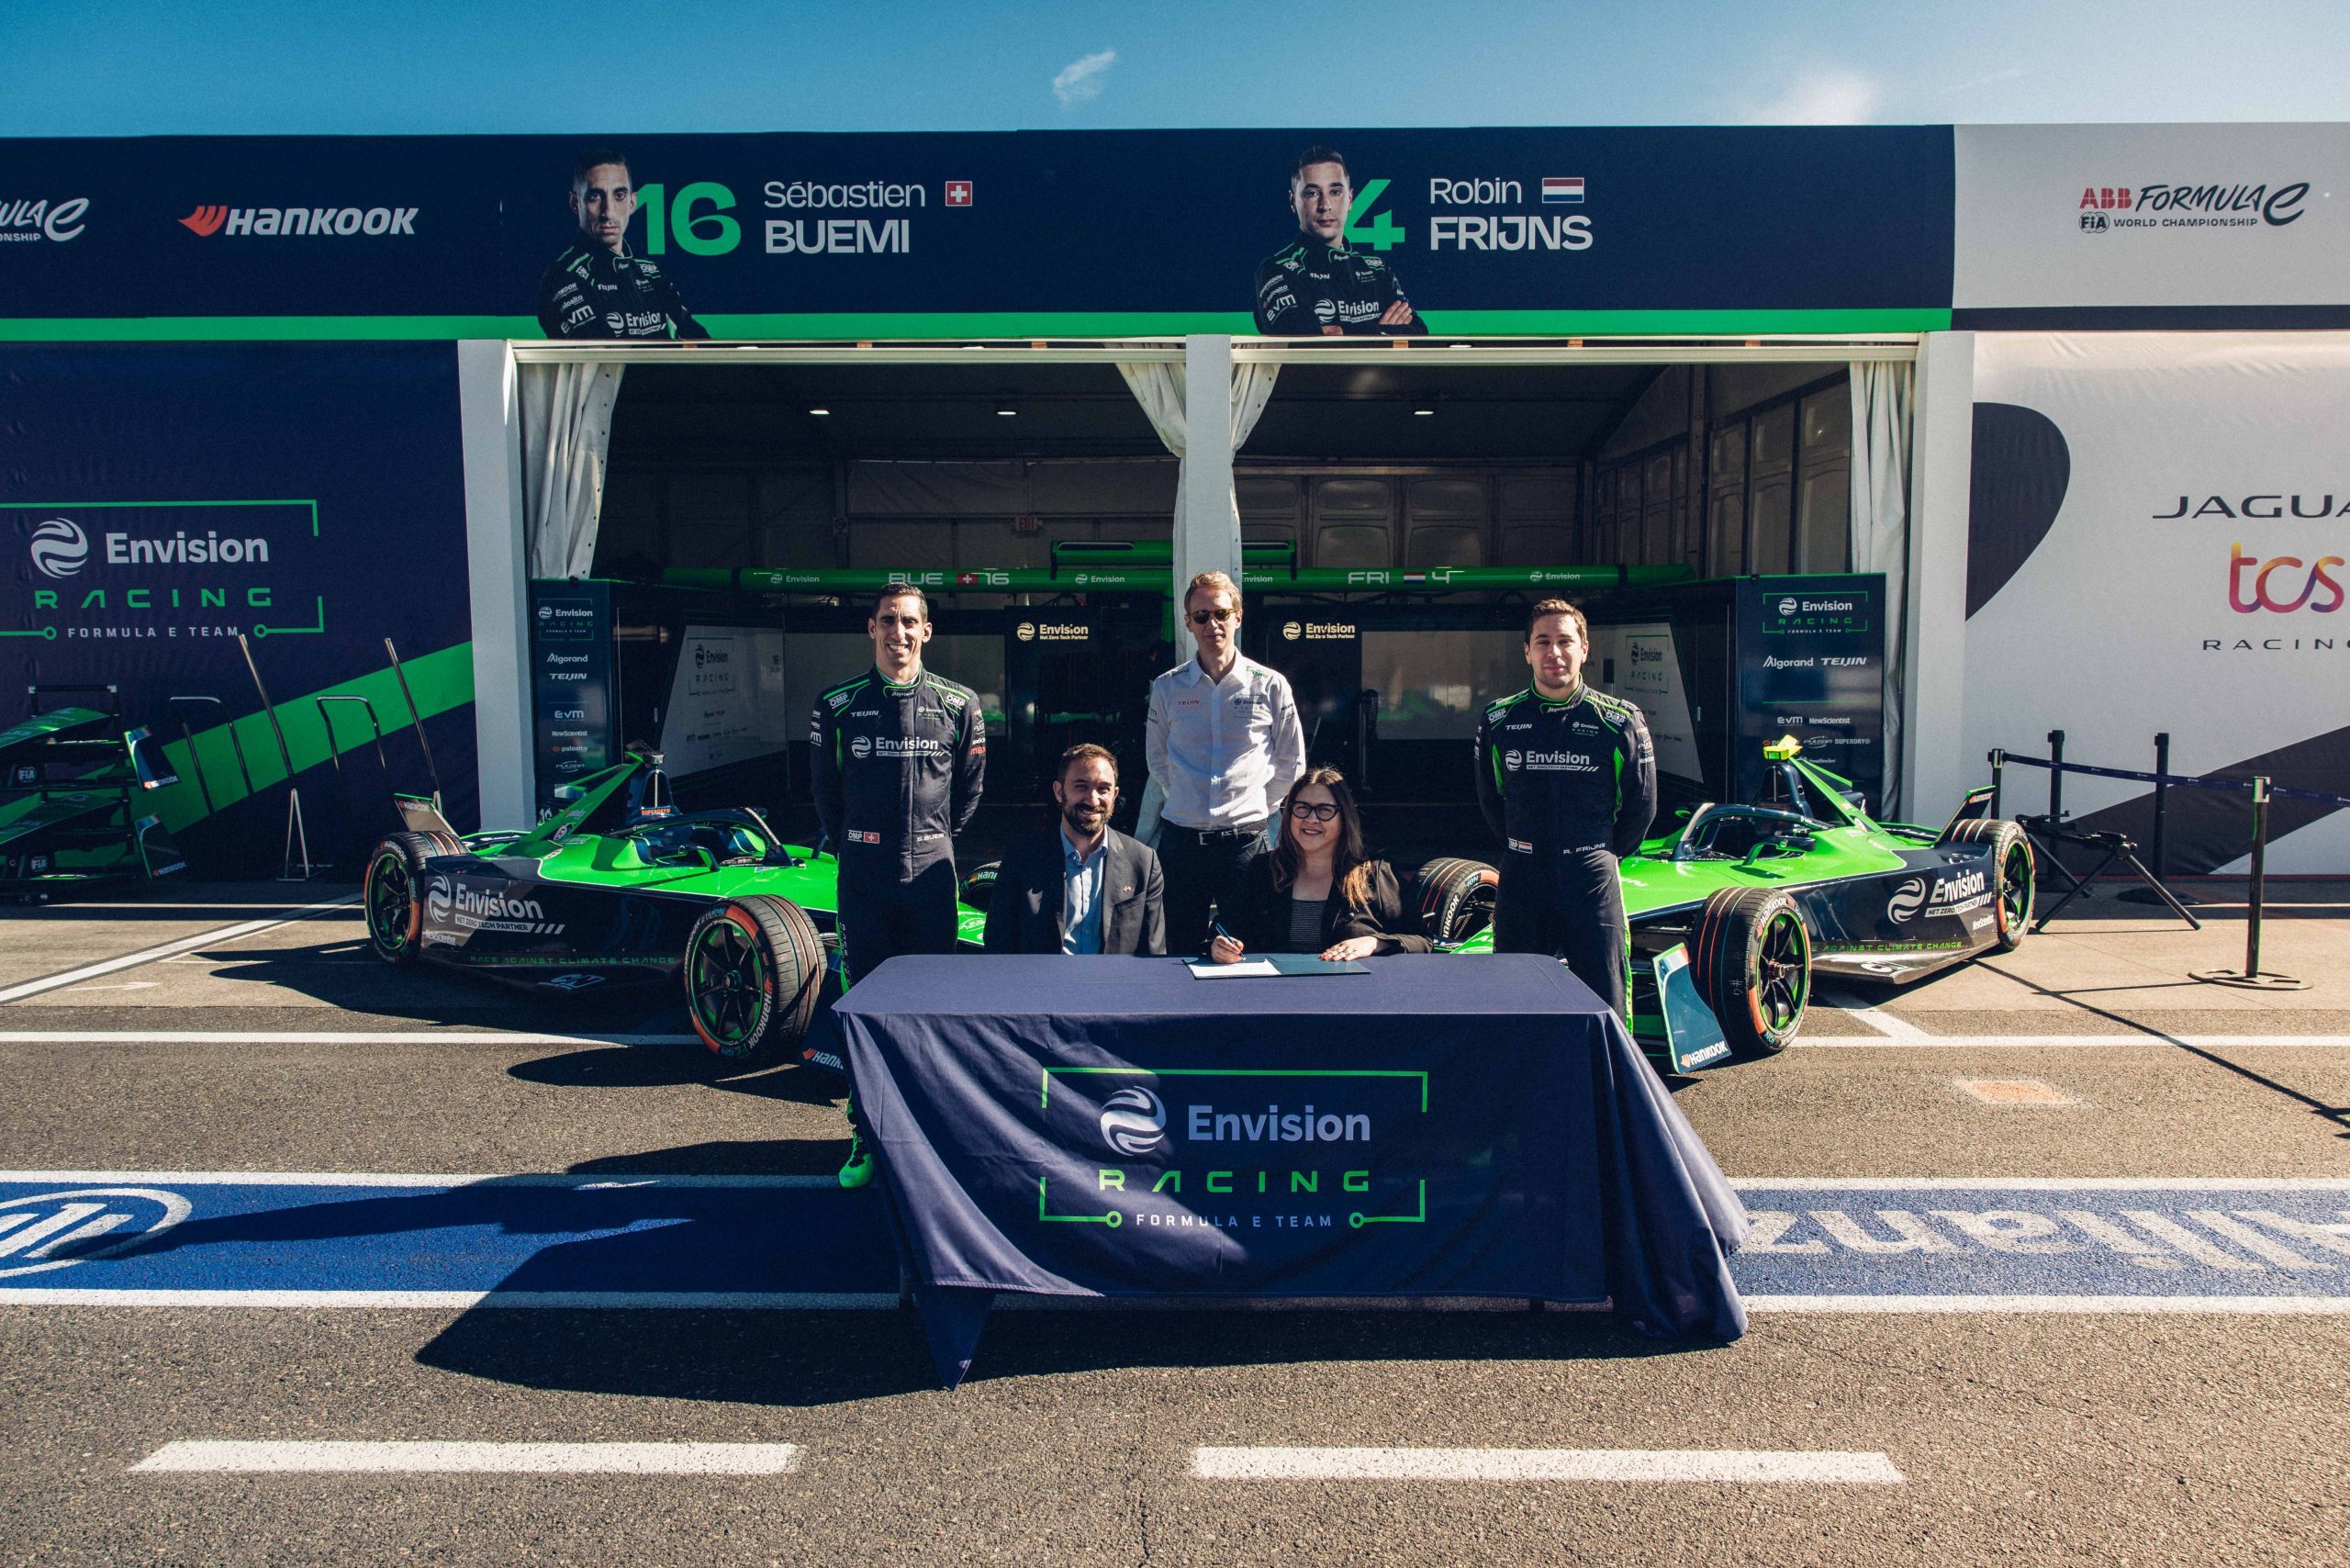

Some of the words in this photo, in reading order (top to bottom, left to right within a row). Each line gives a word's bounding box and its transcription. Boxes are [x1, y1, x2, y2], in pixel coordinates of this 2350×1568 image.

[764, 181, 925, 207] Sébastien
[1430, 177, 1521, 204] Robin
[2079, 188, 2132, 209] ABB
[2135, 185, 2267, 212] FORMULA
[0, 199, 48, 228] ULA
[632, 182, 742, 255] 16
[1345, 179, 1405, 251] 4
[2114, 218, 2157, 228] WORLD
[2162, 218, 2258, 228] CHAMPIONSHIP
[0, 232, 42, 242] NSHIP
[766, 219, 910, 253] BUEMI
[1430, 216, 1593, 251] FRIJNS
[106, 531, 269, 564] Envision
[786, 575, 820, 583] Envision
[889, 573, 944, 585] BUE
[985, 573, 1010, 585] 16
[1091, 575, 1125, 583] Envision
[1348, 572, 1390, 585] FRI
[1432, 572, 1449, 584] 4
[1546, 572, 1581, 580] Envision
[35, 588, 272, 609] RACING
[1802, 600, 1852, 611] Envision
[555, 609, 593, 617] Envision
[1778, 617, 1852, 625] RACING
[68, 627, 156, 638] FORMULA
[168, 627, 177, 637] E
[189, 626, 238, 637] TEAM
[1039, 624, 1088, 634] Envision
[1306, 623, 1356, 633] Envision
[547, 653, 588, 664] Algorand
[1762, 655, 1814, 669] Algorand
[1821, 657, 1867, 666] TEIJIN
[829, 693, 849, 706] OMP
[946, 695, 966, 707] OMP
[1488, 710, 1506, 722] OMP
[1606, 711, 1625, 724] OMP
[876, 736, 939, 750] Envision
[1527, 751, 1590, 766] Envision
[848, 832, 863, 840] OMP
[1576, 843, 1606, 853] FRIJNS
[1930, 869, 1986, 904] Envision
[455, 883, 544, 919] Envision
[465, 918, 477, 927] ZERO
[478, 921, 496, 929] TECH
[497, 923, 529, 931] PARTNER
[1823, 944, 1873, 952] AGAINST
[1926, 941, 1963, 949] CHANGE
[1188, 1104, 1371, 1142] Envision
[1099, 1170, 1370, 1193] RACING
[1136, 1214, 1238, 1227] FORMULA
[1252, 1215, 1261, 1227] E
[1276, 1215, 1333, 1227] TEAM
